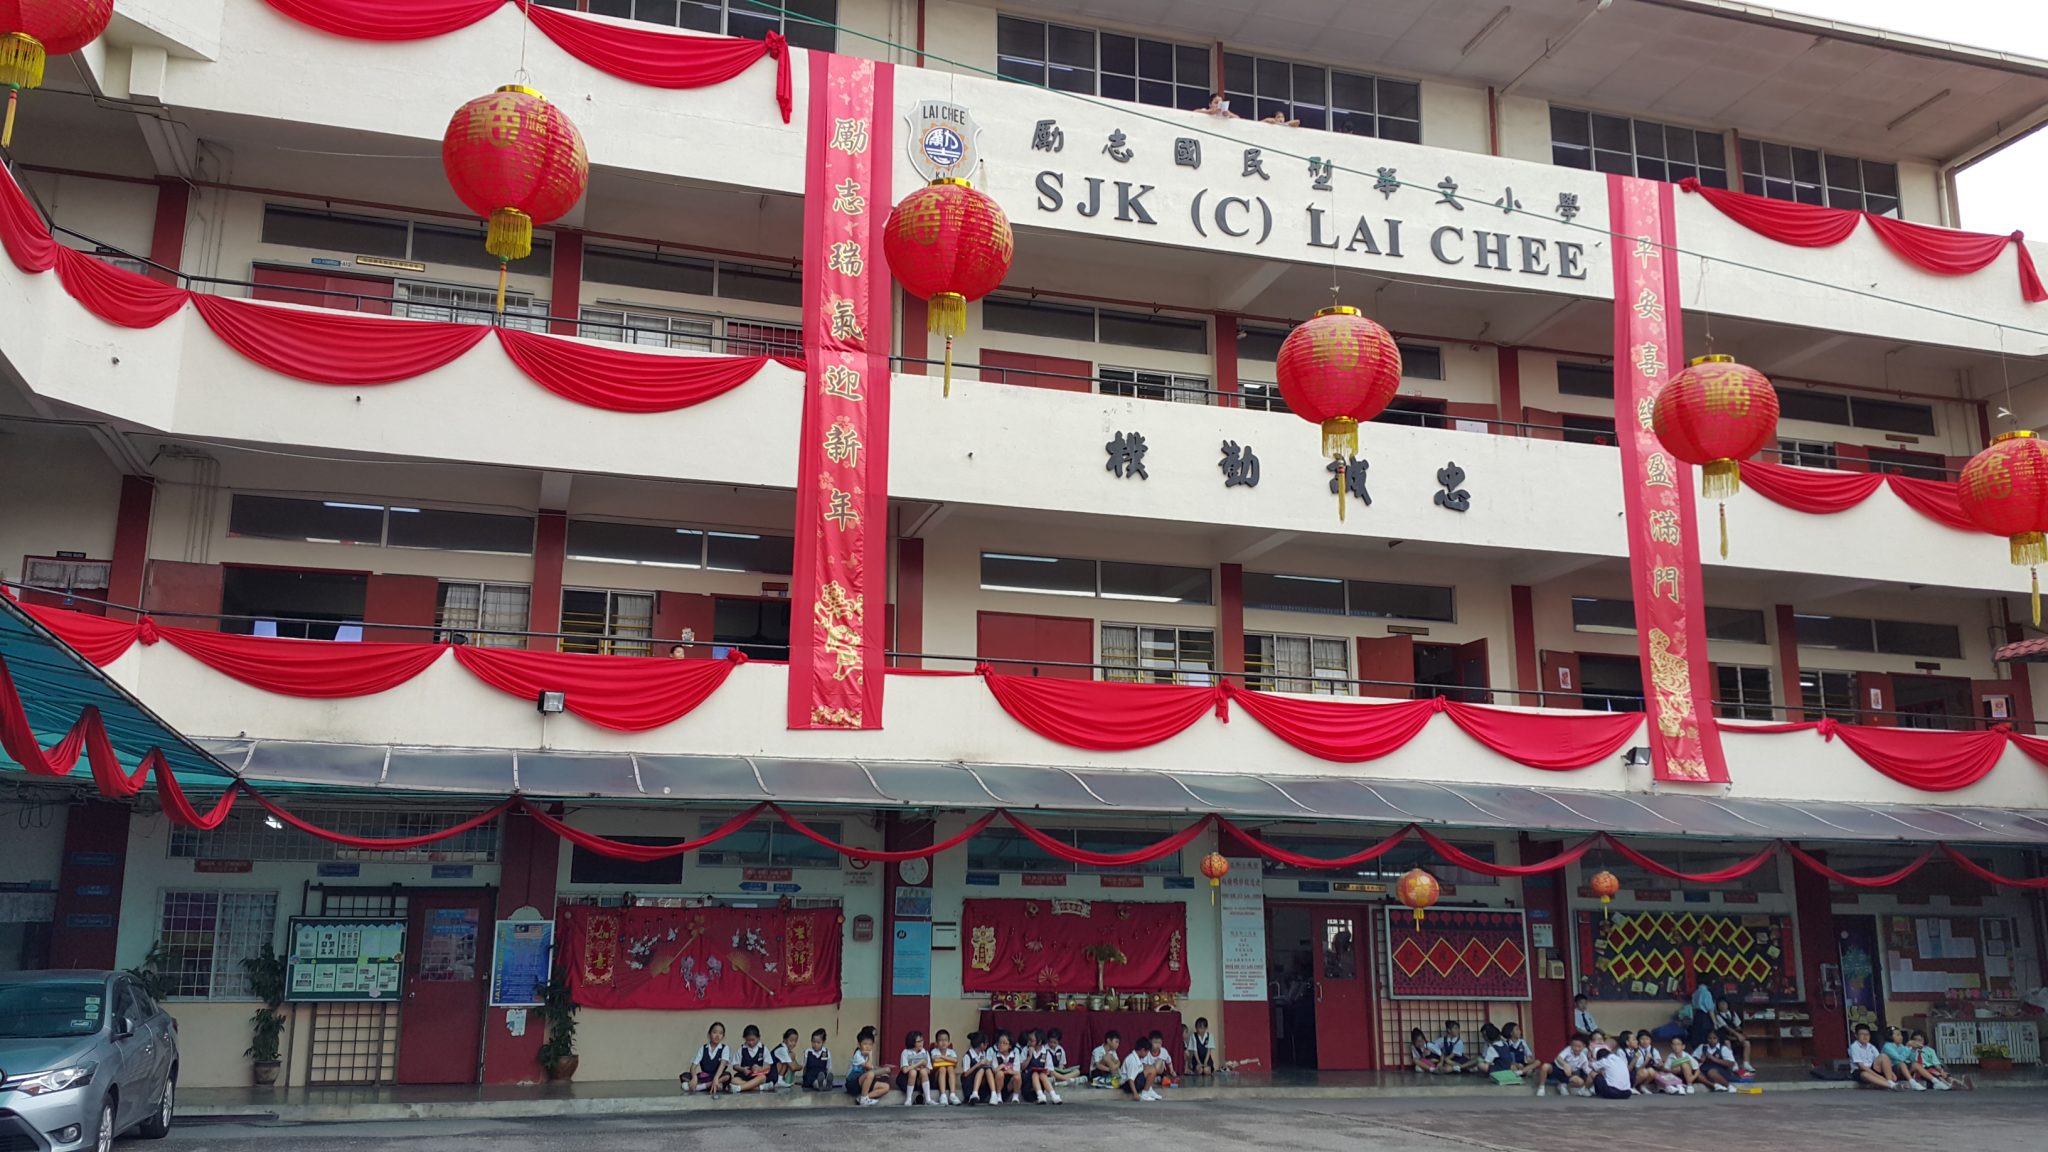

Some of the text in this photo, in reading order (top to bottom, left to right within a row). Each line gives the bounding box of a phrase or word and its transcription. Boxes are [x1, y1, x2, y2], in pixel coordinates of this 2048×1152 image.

[923, 105, 965, 125] LAI CHEE
[1035, 171, 1587, 280] SJK (C) LAI CHEE
